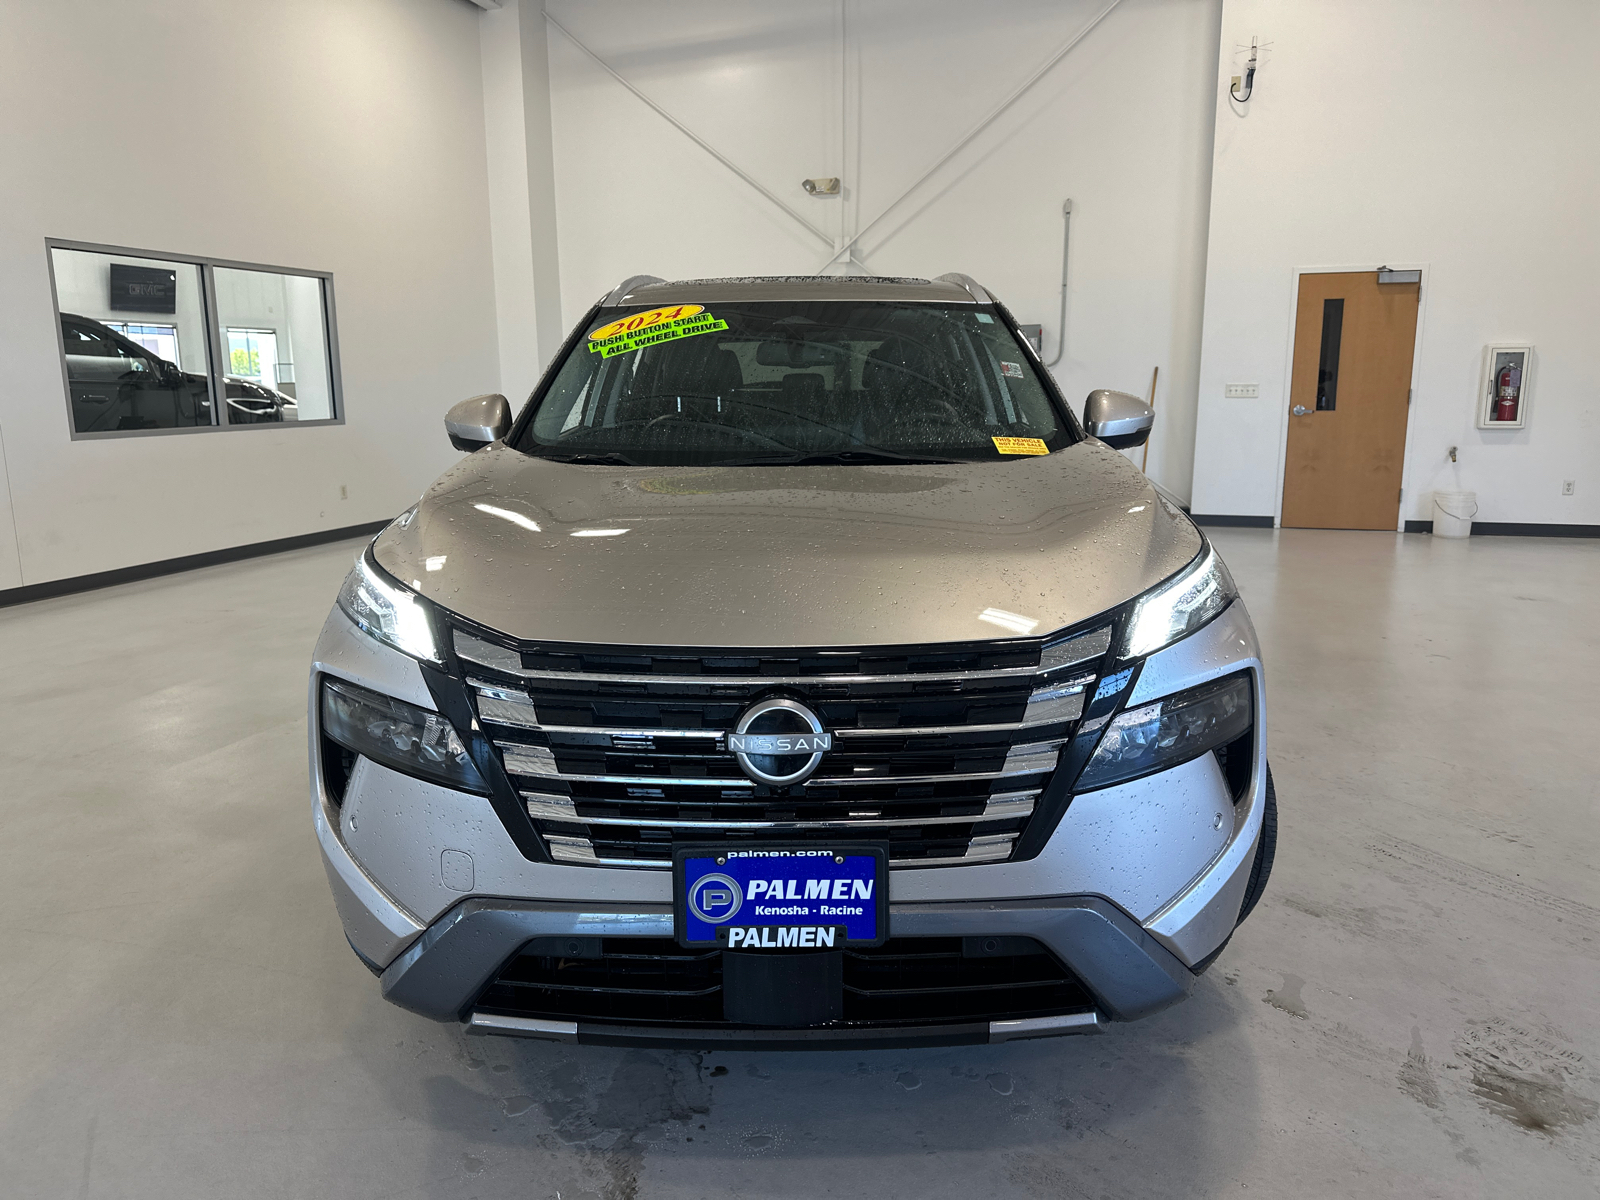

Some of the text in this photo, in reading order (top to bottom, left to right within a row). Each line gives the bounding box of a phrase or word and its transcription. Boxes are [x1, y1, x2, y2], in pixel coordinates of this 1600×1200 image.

[129, 283, 165, 295] GMC
[592, 314, 710, 350] PUSH BUTTON START
[607, 307, 684, 337] 2024
[606, 322, 723, 355] ALL WHEEL DRIVE
[730, 736, 828, 751] NISSAN
[727, 850, 833, 859] palmen.com
[703, 889, 732, 910] P
[746, 879, 874, 900] PALMEN
[755, 905, 809, 915] Kenosha
[820, 905, 863, 915] Racine
[728, 927, 835, 948] PALMEN
